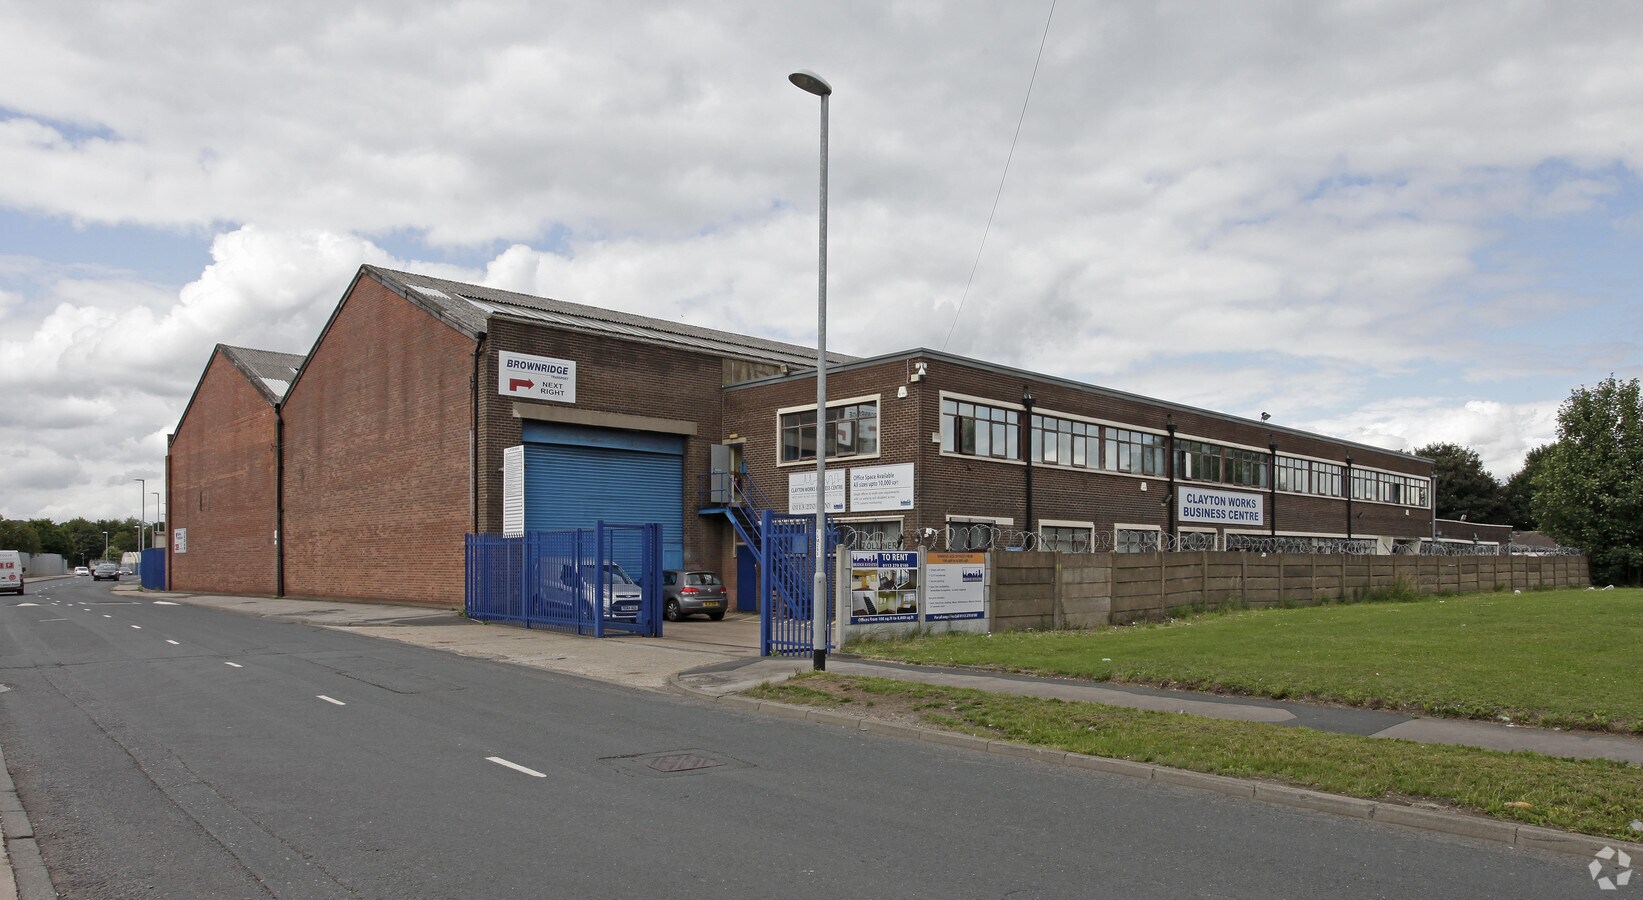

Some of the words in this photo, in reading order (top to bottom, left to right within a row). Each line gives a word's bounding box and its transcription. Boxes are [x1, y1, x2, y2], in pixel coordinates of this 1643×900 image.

[507, 359, 568, 375] BROWNRIDGE
[541, 388, 565, 396] RIGHT
[865, 473, 876, 481] Space
[1186, 493, 1226, 506] CLAYTON
[1228, 497, 1257, 509] WORKS
[1183, 506, 1226, 519] BUSINESS
[1228, 510, 1259, 521] CENTRE
[882, 553, 890, 561] TO
[892, 553, 908, 561] RENT
